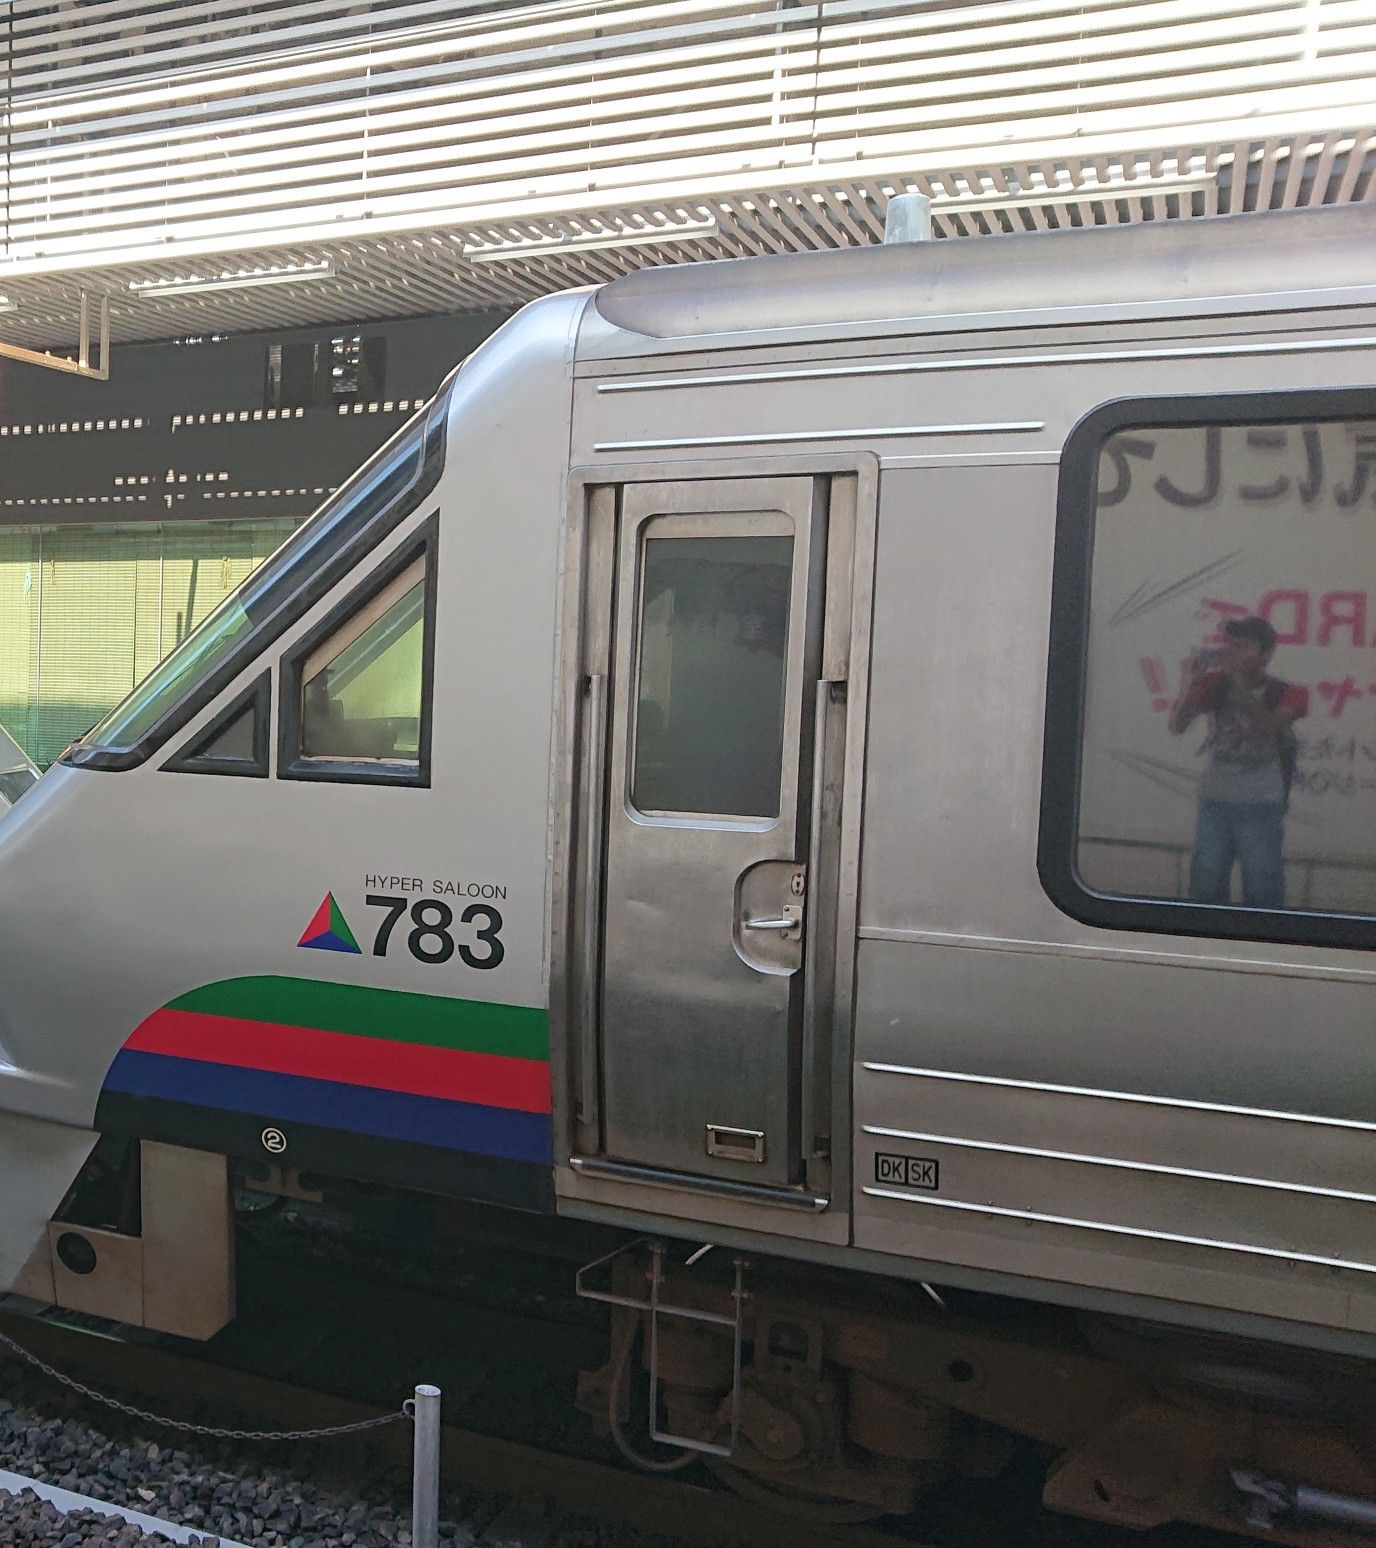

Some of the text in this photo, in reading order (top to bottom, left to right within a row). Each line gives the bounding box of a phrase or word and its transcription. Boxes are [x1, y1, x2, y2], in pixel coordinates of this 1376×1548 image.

[364, 873, 508, 901] HYPER SALOON
[365, 894, 505, 970] 783
[881, 1159, 933, 1184] DK SK
